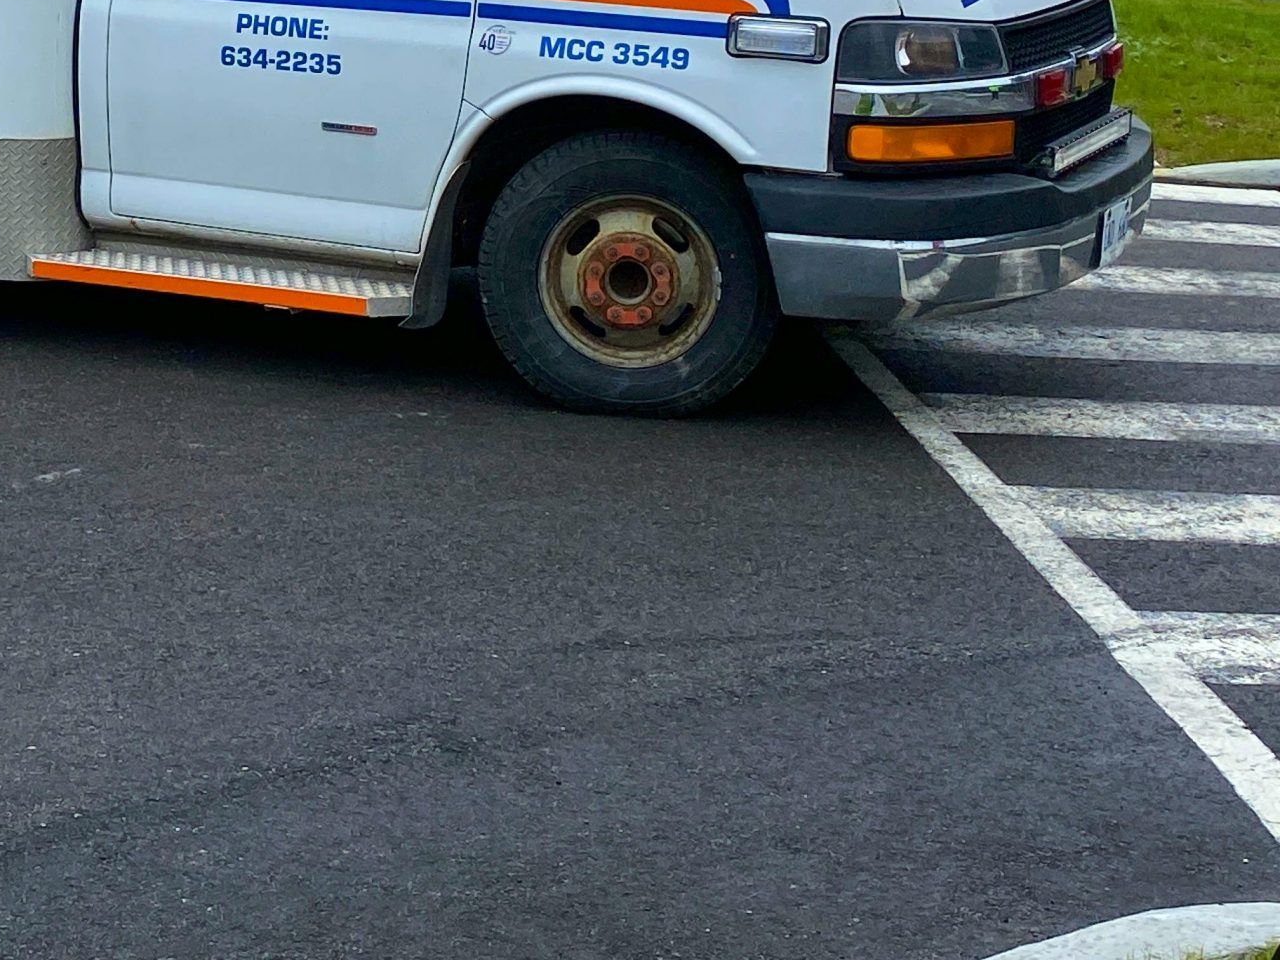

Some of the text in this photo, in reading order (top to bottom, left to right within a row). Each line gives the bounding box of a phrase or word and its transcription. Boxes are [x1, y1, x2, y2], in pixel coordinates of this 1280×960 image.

[235, 13, 330, 40] PHONE:
[479, 32, 496, 51] 40
[538, 36, 605, 63] MCC
[611, 42, 690, 71] 3549
[220, 45, 343, 76] 634-2235
